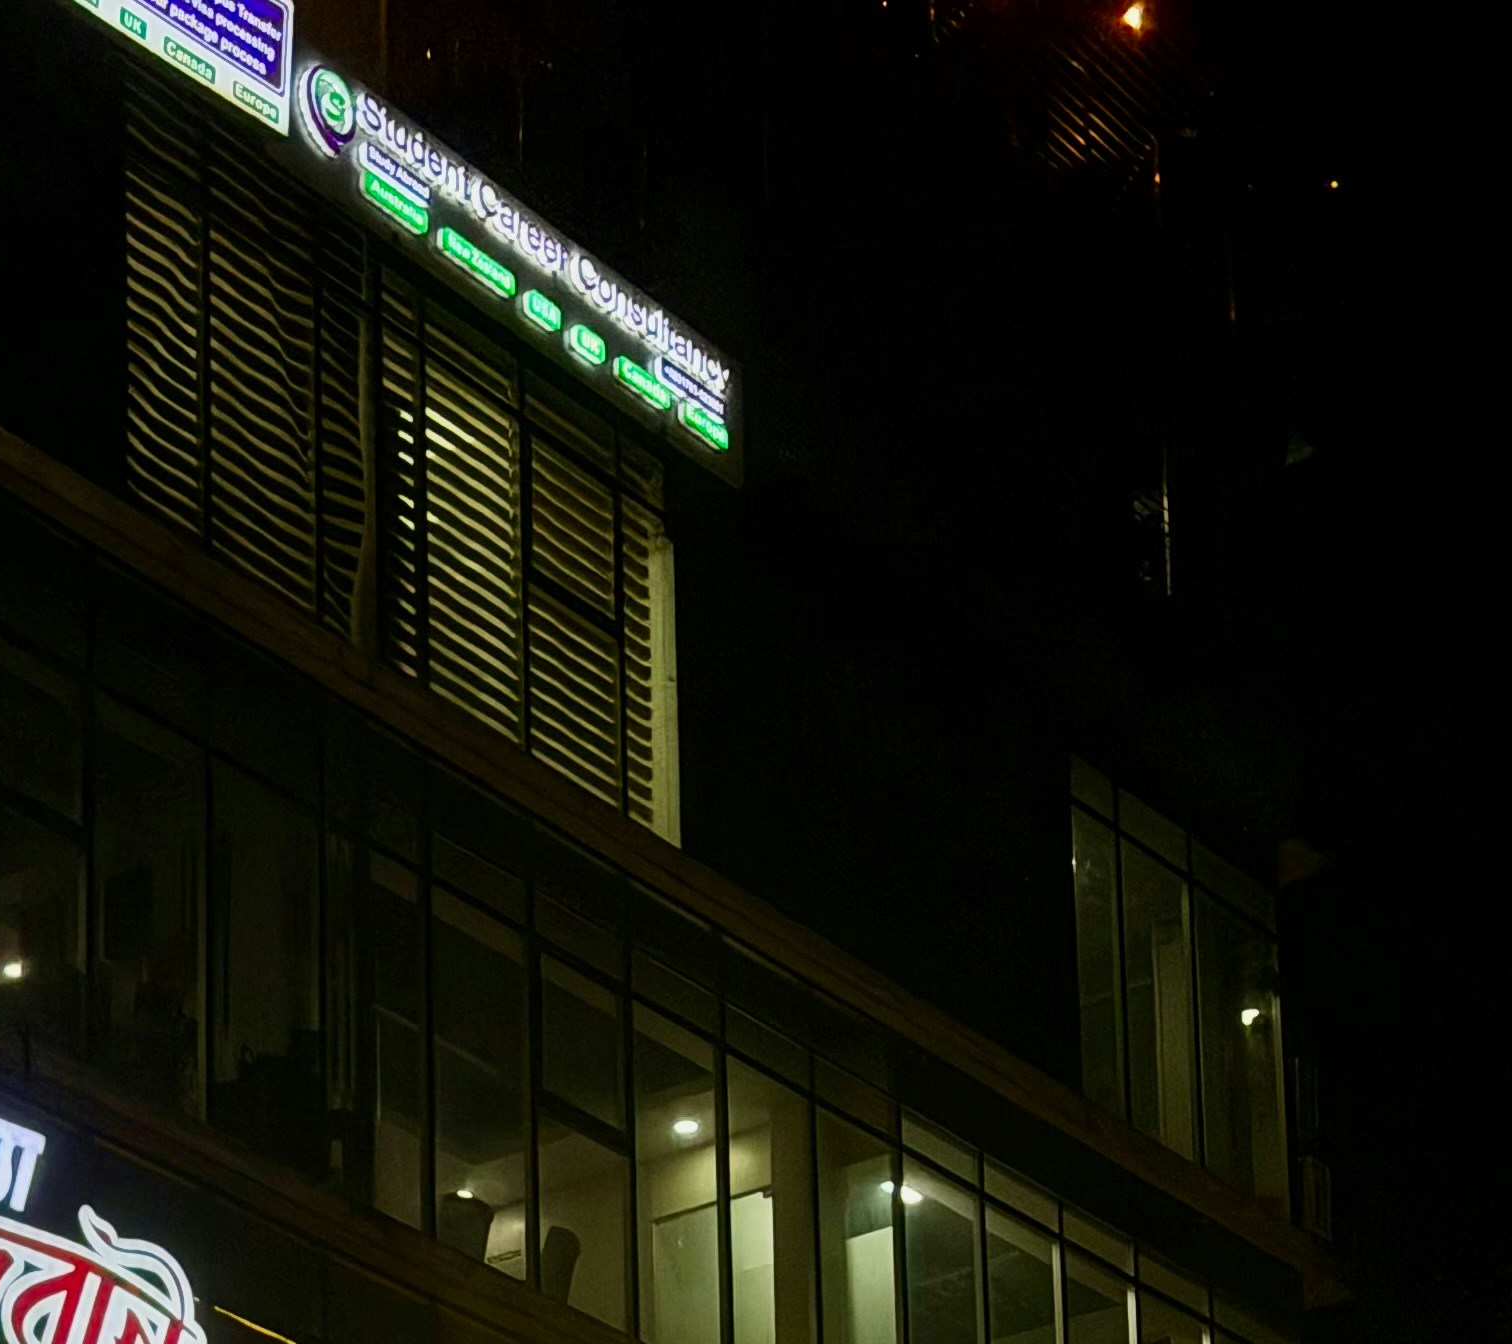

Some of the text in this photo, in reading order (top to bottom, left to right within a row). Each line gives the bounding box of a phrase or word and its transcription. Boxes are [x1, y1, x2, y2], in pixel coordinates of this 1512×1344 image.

[123, 12, 278, 120] UK Canada Europe
[356, 91, 470, 207] Student
[470, 174, 568, 275] Career
[370, 180, 424, 226] Australia
[532, 296, 557, 321] USA
[624, 361, 668, 406] Canada
